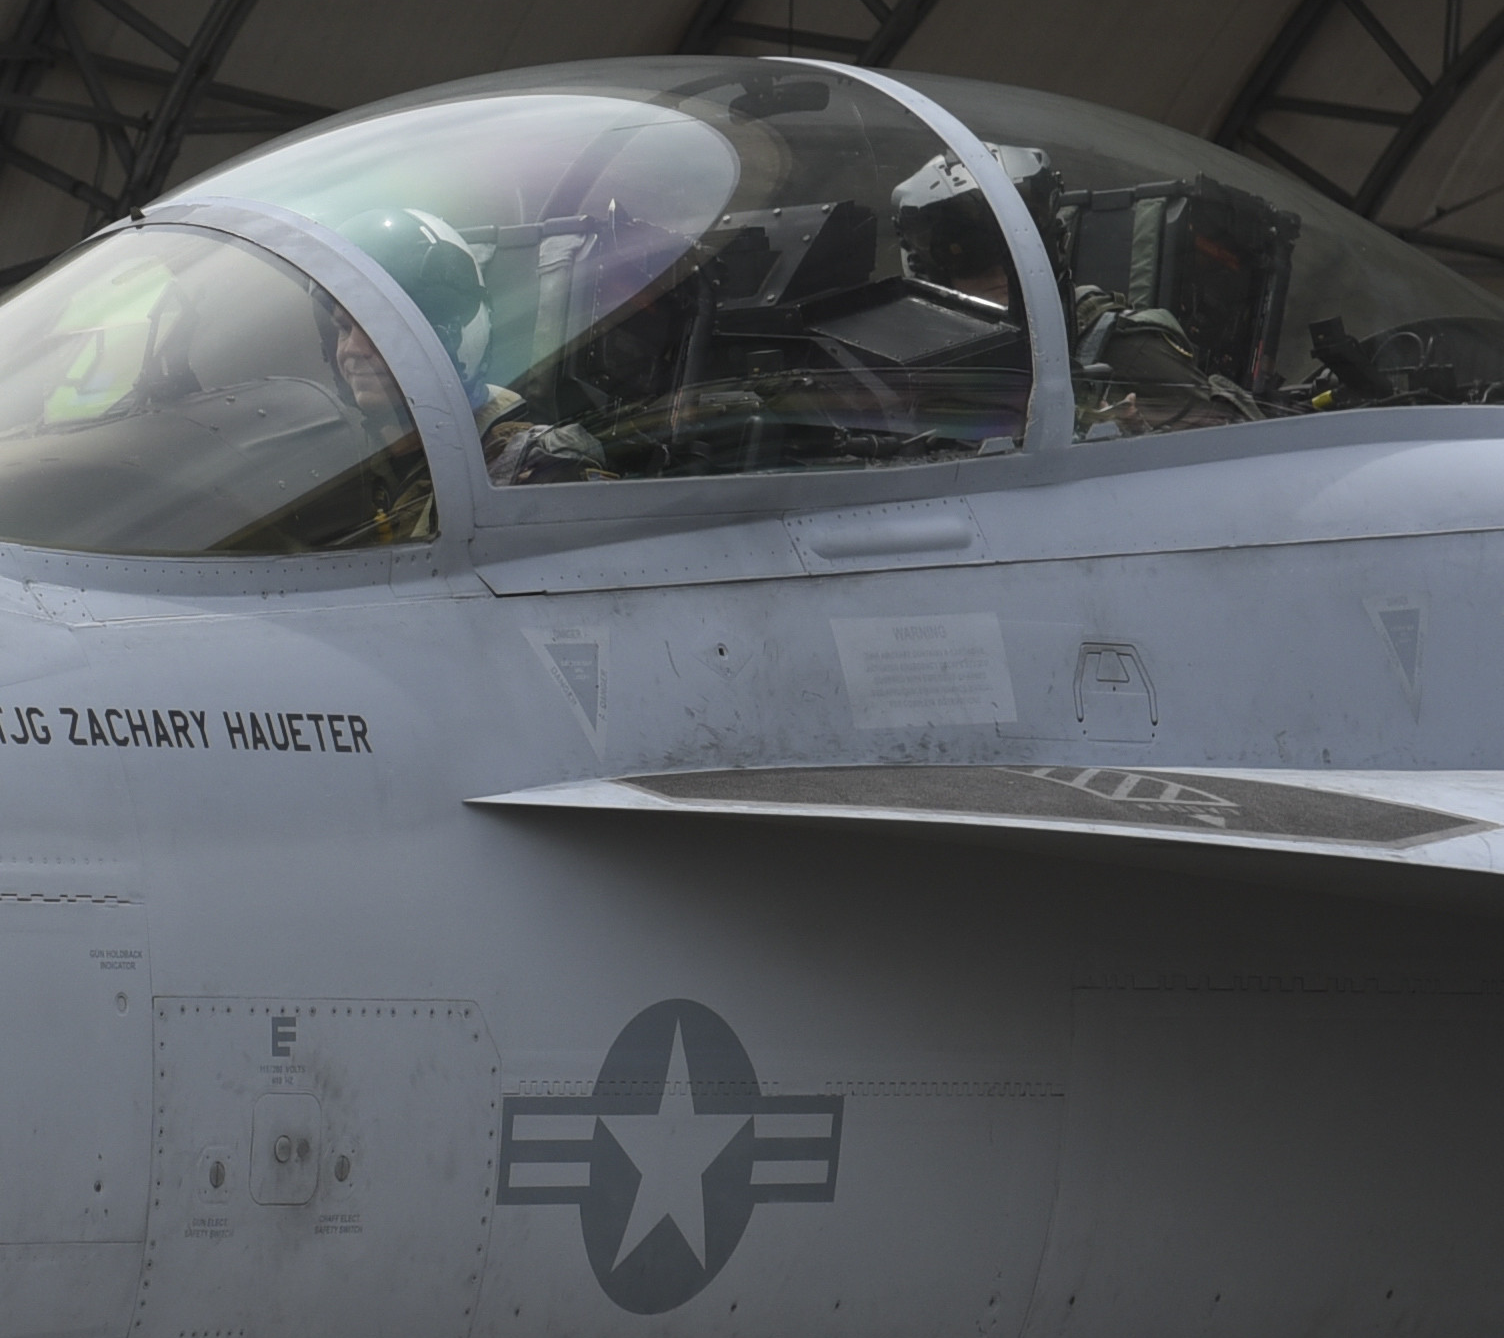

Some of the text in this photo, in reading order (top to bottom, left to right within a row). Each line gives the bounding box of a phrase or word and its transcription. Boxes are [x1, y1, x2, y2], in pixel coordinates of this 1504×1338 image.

[891, 624, 948, 641] WARNING
[59, 707, 210, 749] ZACHARY
[222, 711, 374, 754] HAUETER
[271, 1016, 297, 1058] E
